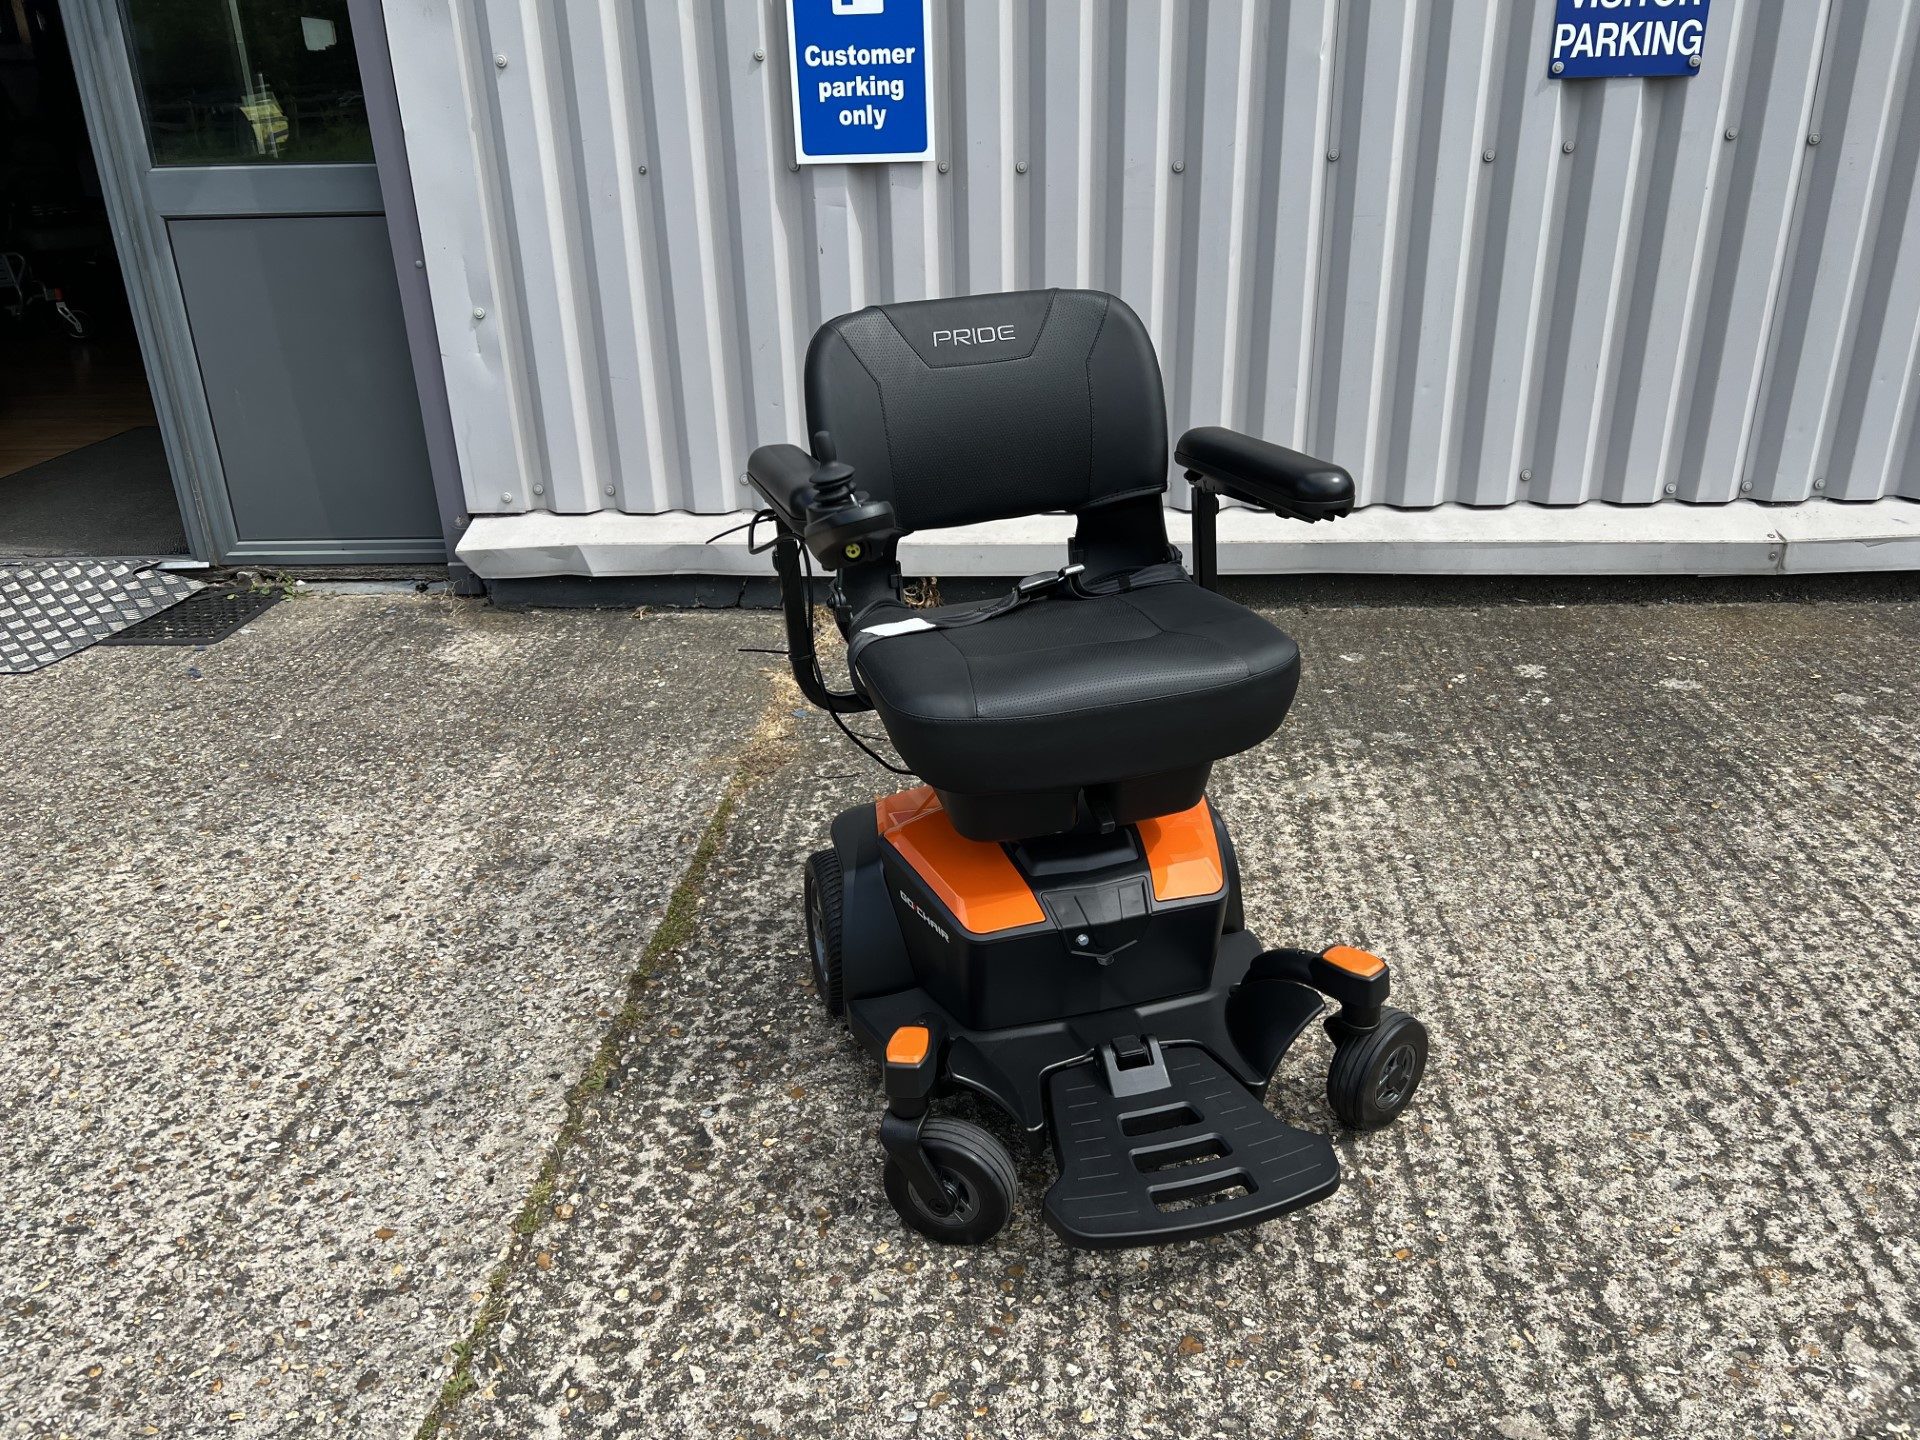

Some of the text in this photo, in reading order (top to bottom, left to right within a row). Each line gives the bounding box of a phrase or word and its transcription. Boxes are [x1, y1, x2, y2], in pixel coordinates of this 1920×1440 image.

[1553, 19, 1703, 58] PARKING
[804, 45, 916, 67] Customer
[818, 75, 904, 102] parking
[839, 104, 887, 130] only
[933, 325, 1016, 347] PRIDE
